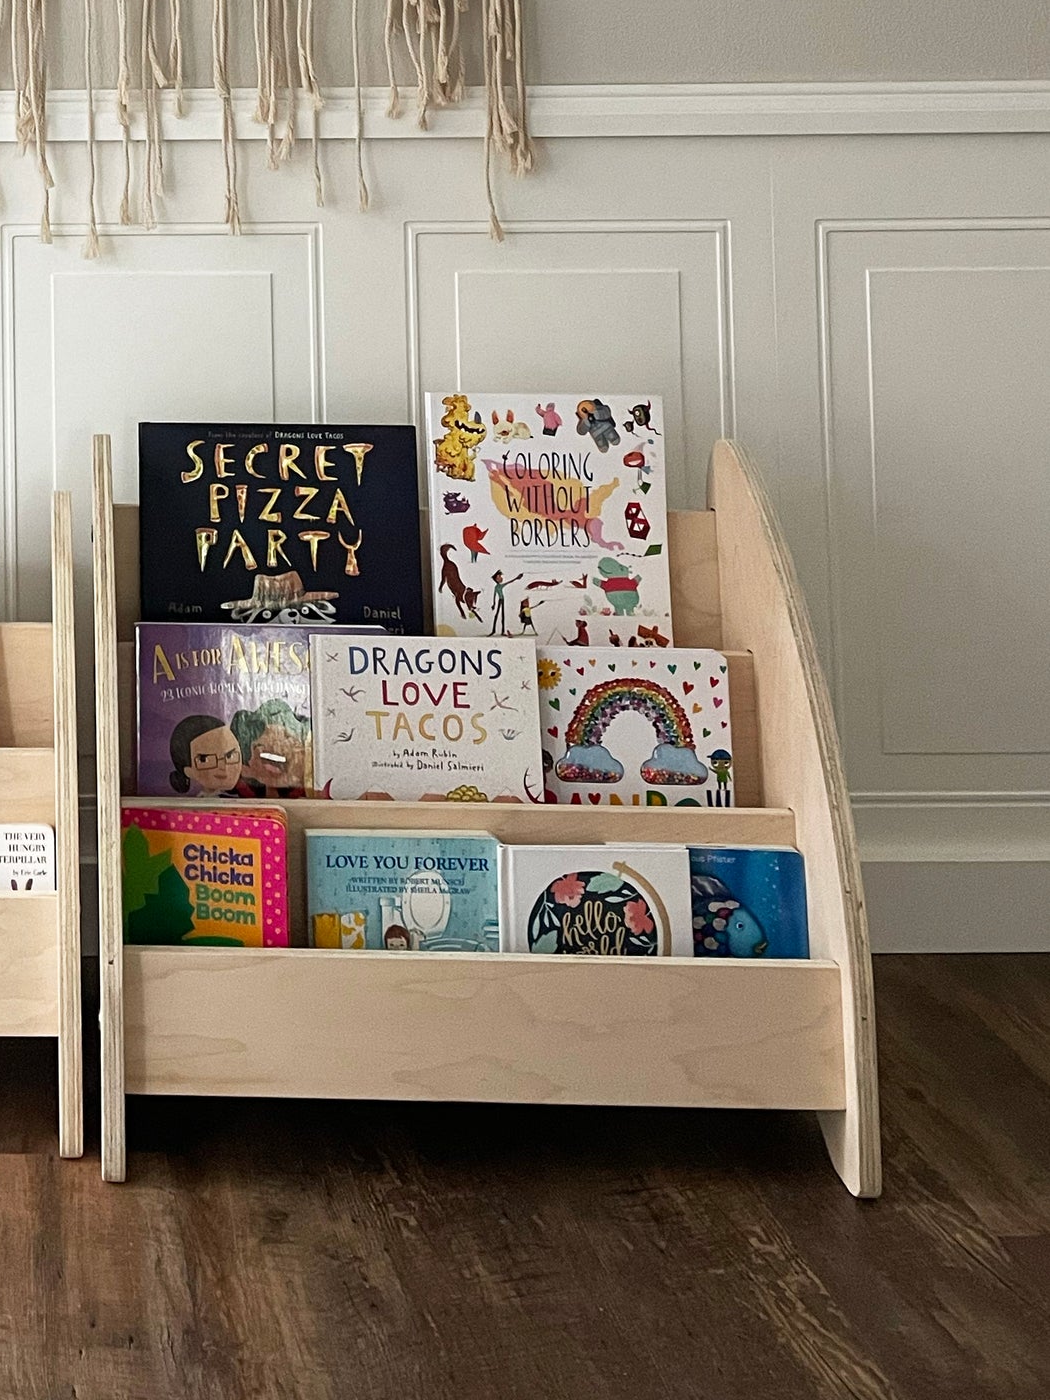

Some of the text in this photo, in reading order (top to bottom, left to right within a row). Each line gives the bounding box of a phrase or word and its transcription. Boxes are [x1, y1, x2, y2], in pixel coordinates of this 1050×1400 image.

[274, 431, 304, 440] DRAGONS
[307, 432, 323, 440] LOVE
[325, 432, 344, 440] TACOS
[180, 440, 374, 486] SECRET
[502, 450, 593, 482] COLORING
[209, 483, 355, 526] PIZZA
[504, 483, 592, 515] WITHOUT
[510, 517, 591, 548] BORDERS
[195, 528, 363, 576] PARTY
[168, 603, 402, 620] Adam Daniel
[153, 635, 311, 685] A IS FOR AWES
[349, 646, 502, 679] DRAGONS
[382, 680, 471, 709] LOVE
[365, 710, 488, 745] TACOS
[403, 749, 429, 757] Adam
[432, 749, 458, 758] Rubin
[417, 760, 444, 770] Daniel
[448, 761, 484, 772] Salmieri
[8, 844, 46, 852] HUNGRY
[24, 832, 46, 841] VERY
[183, 843, 254, 867] Chicka
[326, 855, 490, 872] LOVE YOU FOREVER
[184, 863, 254, 887] Chicka
[351, 877, 387, 885] WRITTEN
[388, 877, 399, 885] BY
[196, 883, 256, 907] Boom
[196, 902, 256, 926] Boom
[562, 900, 621, 946] hello
